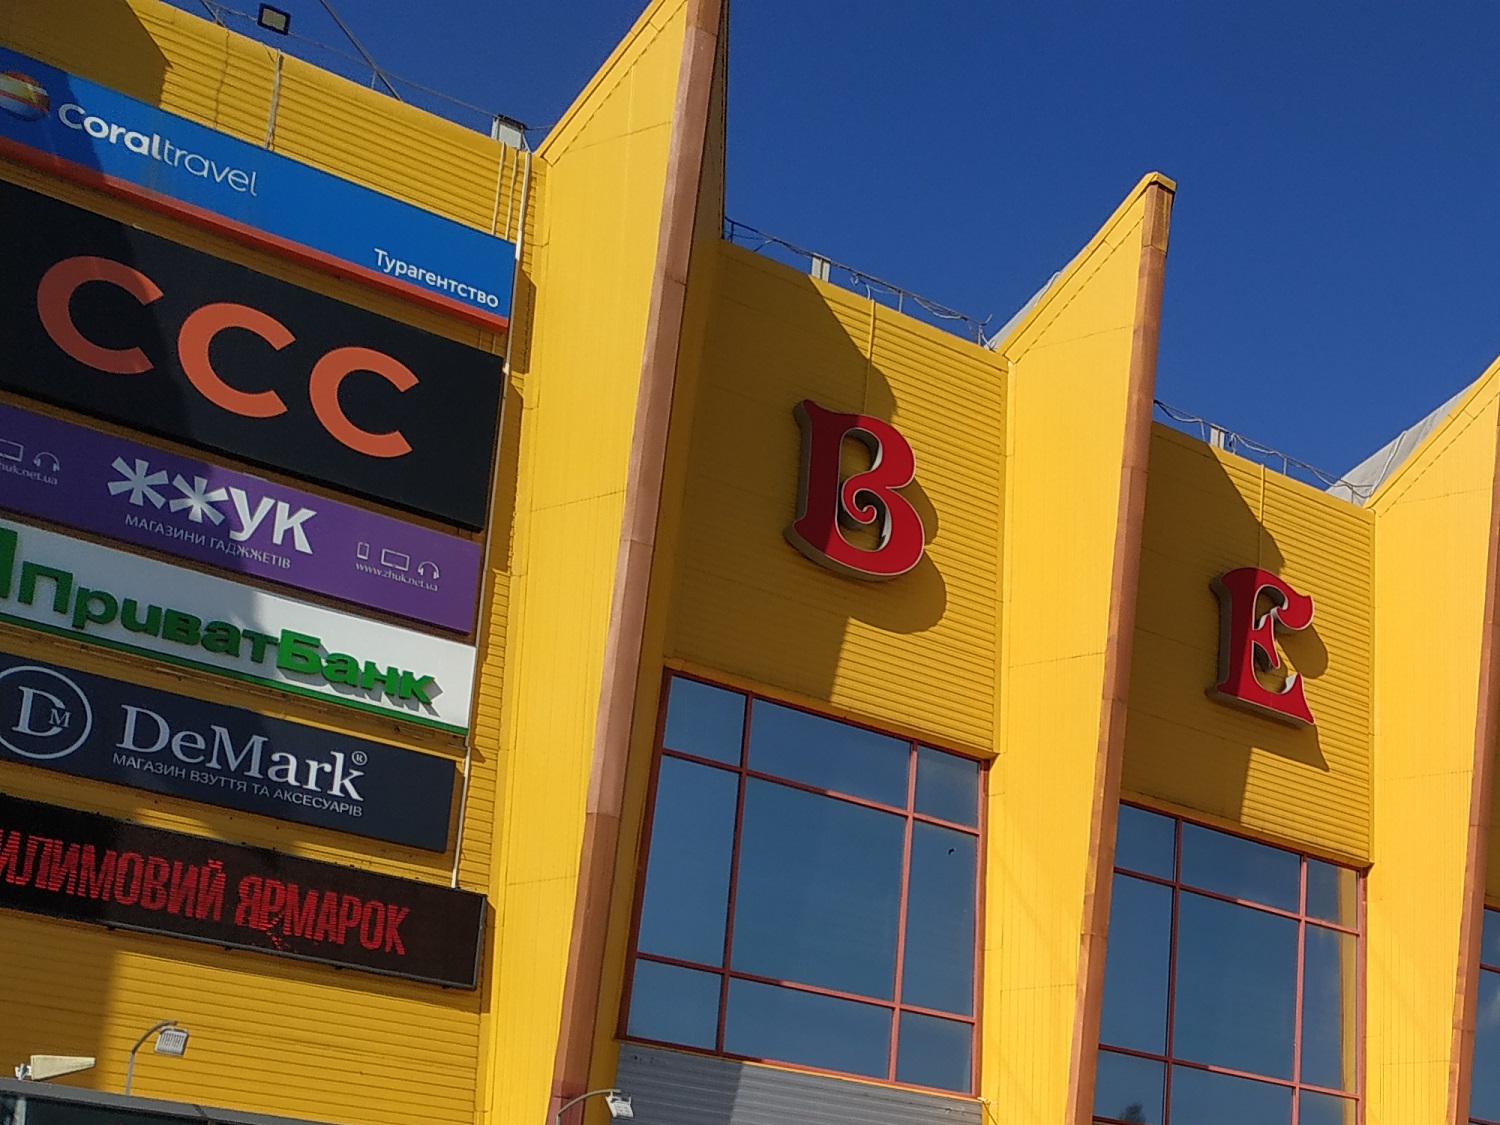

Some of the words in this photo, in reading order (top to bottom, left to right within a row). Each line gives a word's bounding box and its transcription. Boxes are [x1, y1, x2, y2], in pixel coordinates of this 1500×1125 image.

[374, 247, 499, 308] Турагентство
[36, 255, 420, 458] CCC
[125, 514, 206, 546] МАГАЗИНИ
[209, 538, 291, 570] ГАДЖЖЕТІВ
[355, 561, 438, 591] www.zhuk.net.ua
[18, 560, 436, 705] ПриватБанк
[112, 752, 186, 780] МАГАЗИН
[190, 770, 248, 793] ВЗУТТЯ
[252, 783, 270, 797] ТА
[273, 788, 364, 818] АКСЕСУАРІВ
[115, 704, 364, 801] DeMark
[234, 875, 410, 955] ЯРМАРОК
